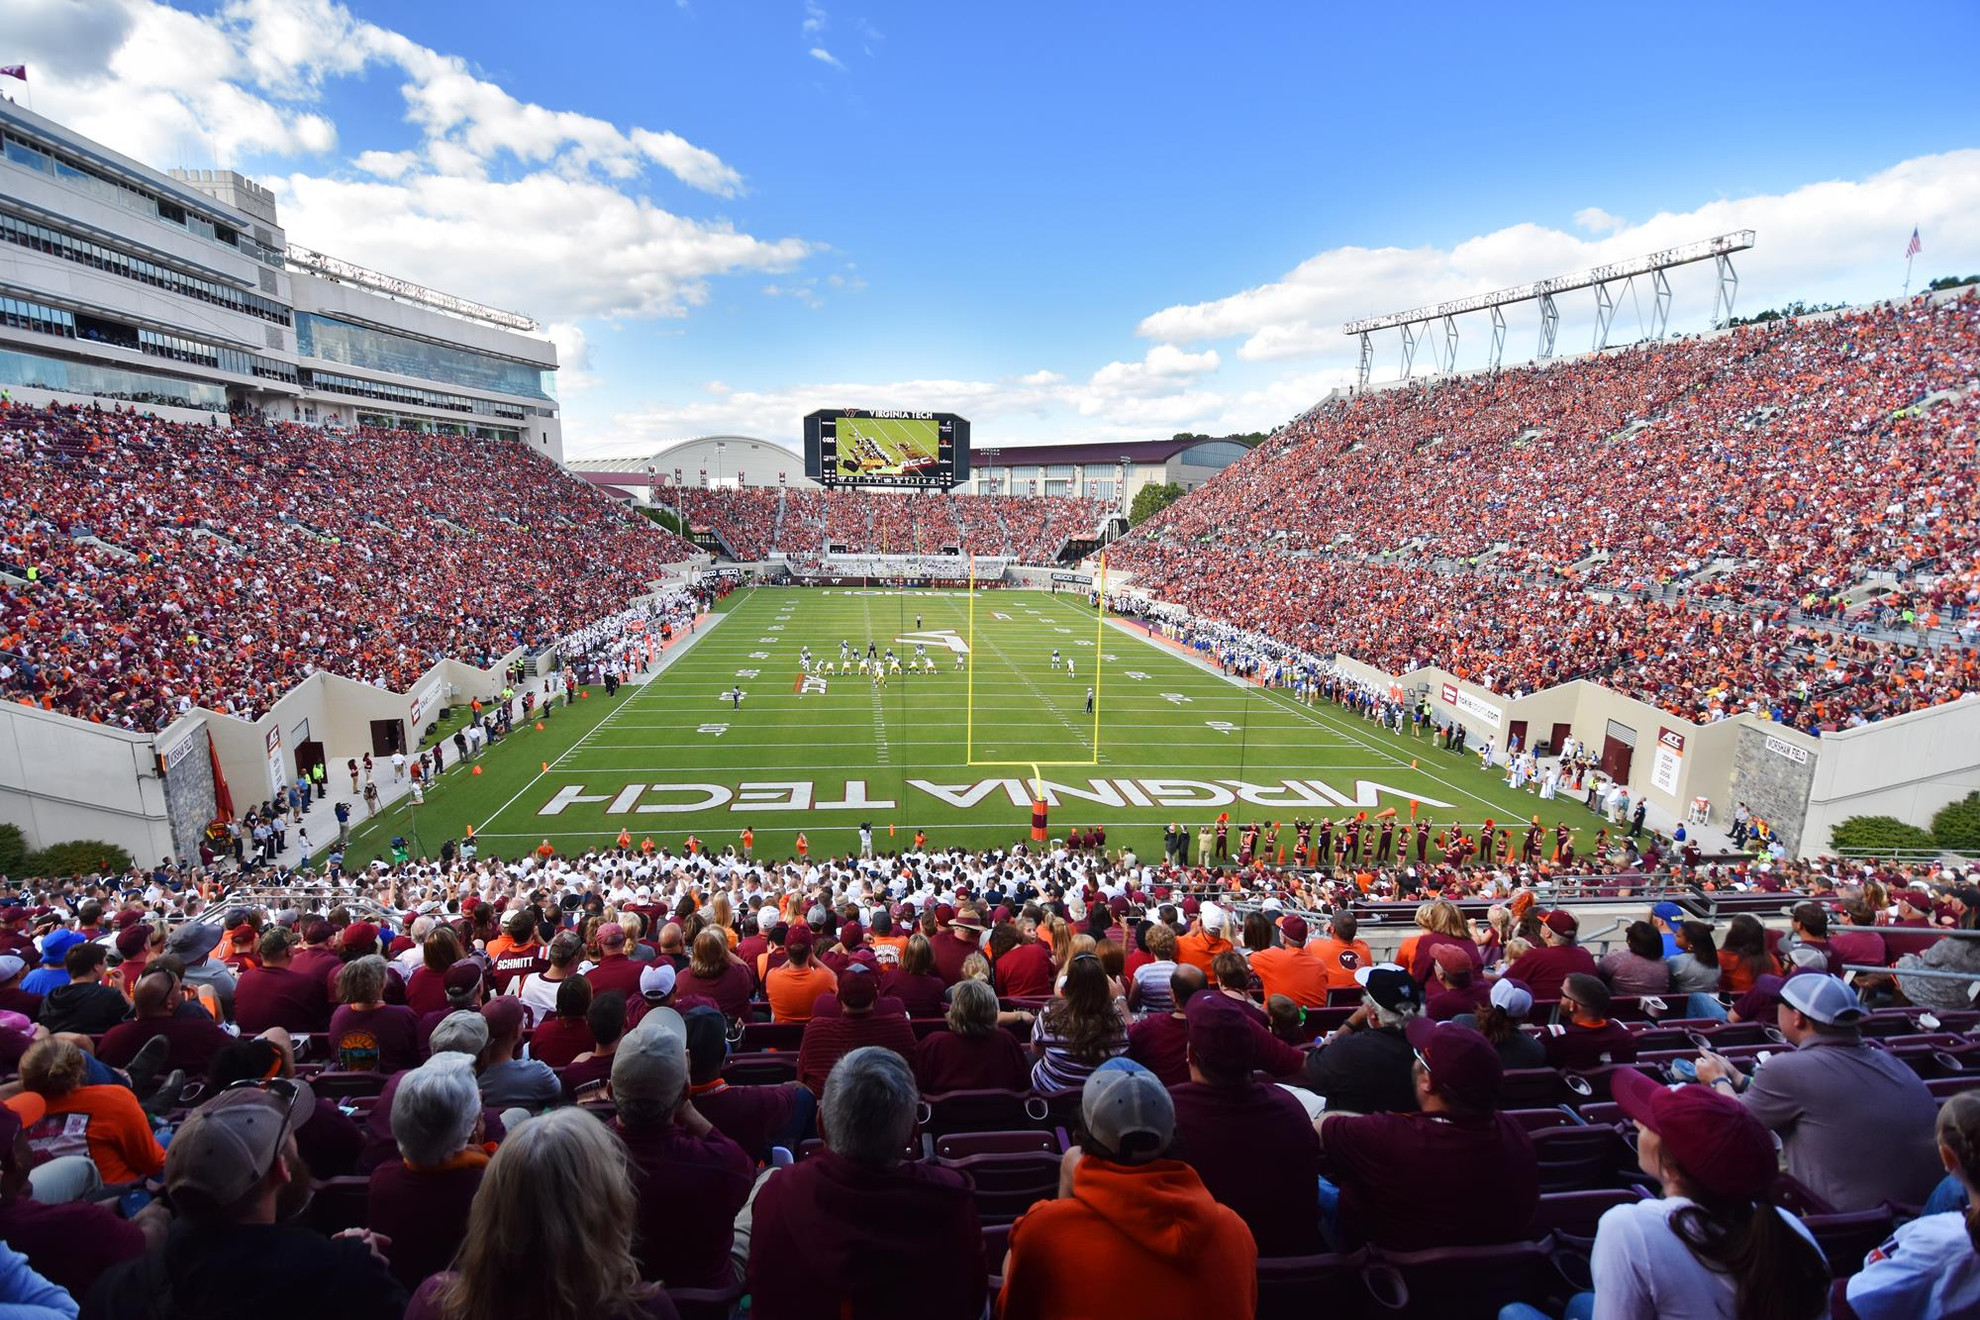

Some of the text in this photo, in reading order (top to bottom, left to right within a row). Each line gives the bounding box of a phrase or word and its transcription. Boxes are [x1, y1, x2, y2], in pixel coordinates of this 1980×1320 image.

[869, 410, 933, 420] VIRGINIA TECH
[1052, 573, 1073, 581] GEICO
[1075, 575, 1092, 583] GEICO
[1662, 731, 1682, 747] ACC
[1767, 738, 1806, 762] WORSHAM FIELD
[536, 777, 1459, 816] VIRGINIA TECH
[497, 956, 534, 971] SCHMITT
[1342, 954, 1353, 962] VT
